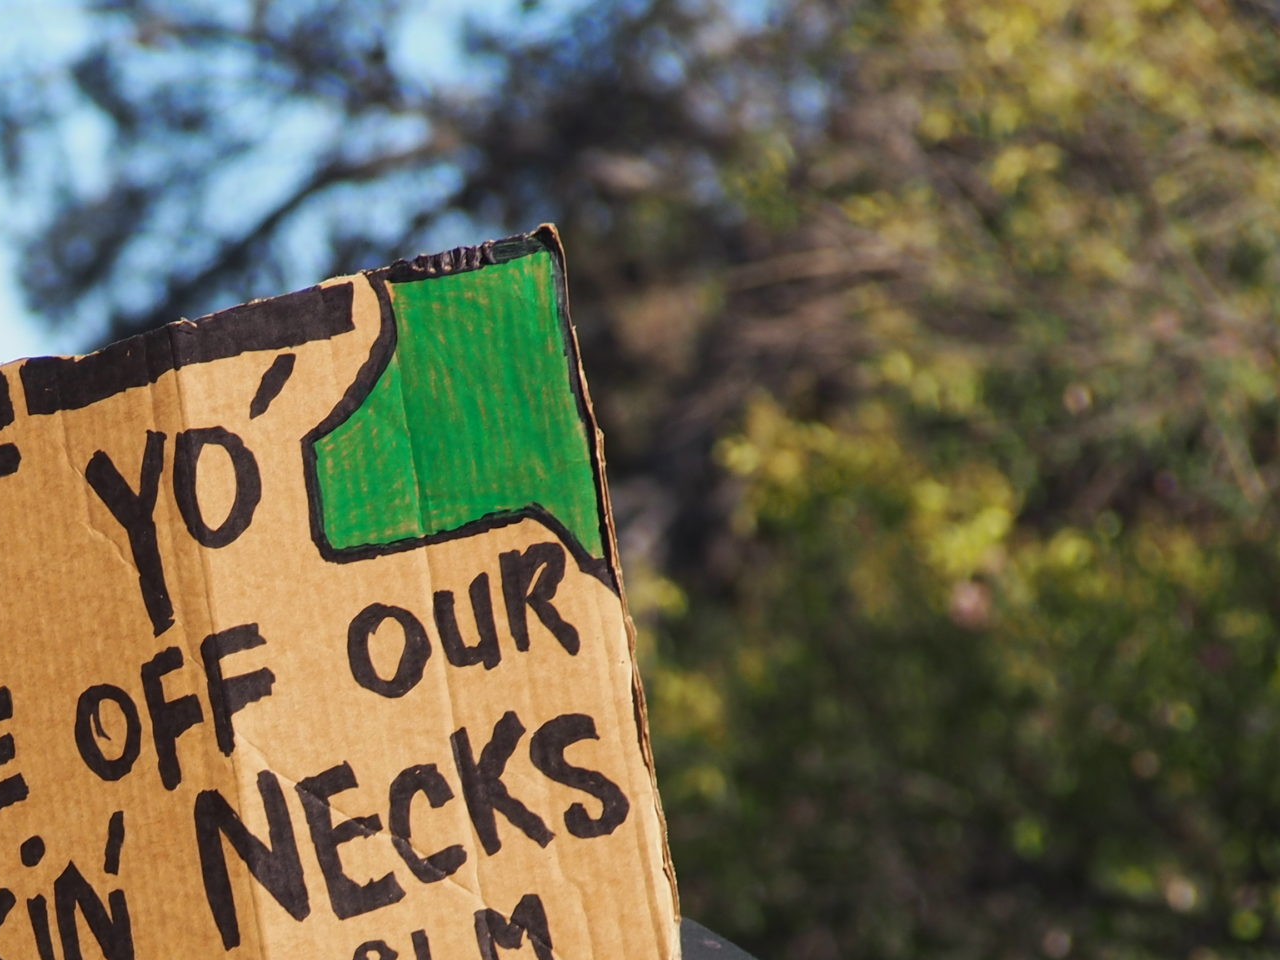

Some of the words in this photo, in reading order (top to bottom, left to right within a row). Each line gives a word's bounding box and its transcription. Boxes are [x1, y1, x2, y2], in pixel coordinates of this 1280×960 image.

[74, 622, 277, 791] OFF
[346, 541, 580, 699] OUR
[192, 710, 630, 951] NECKS
